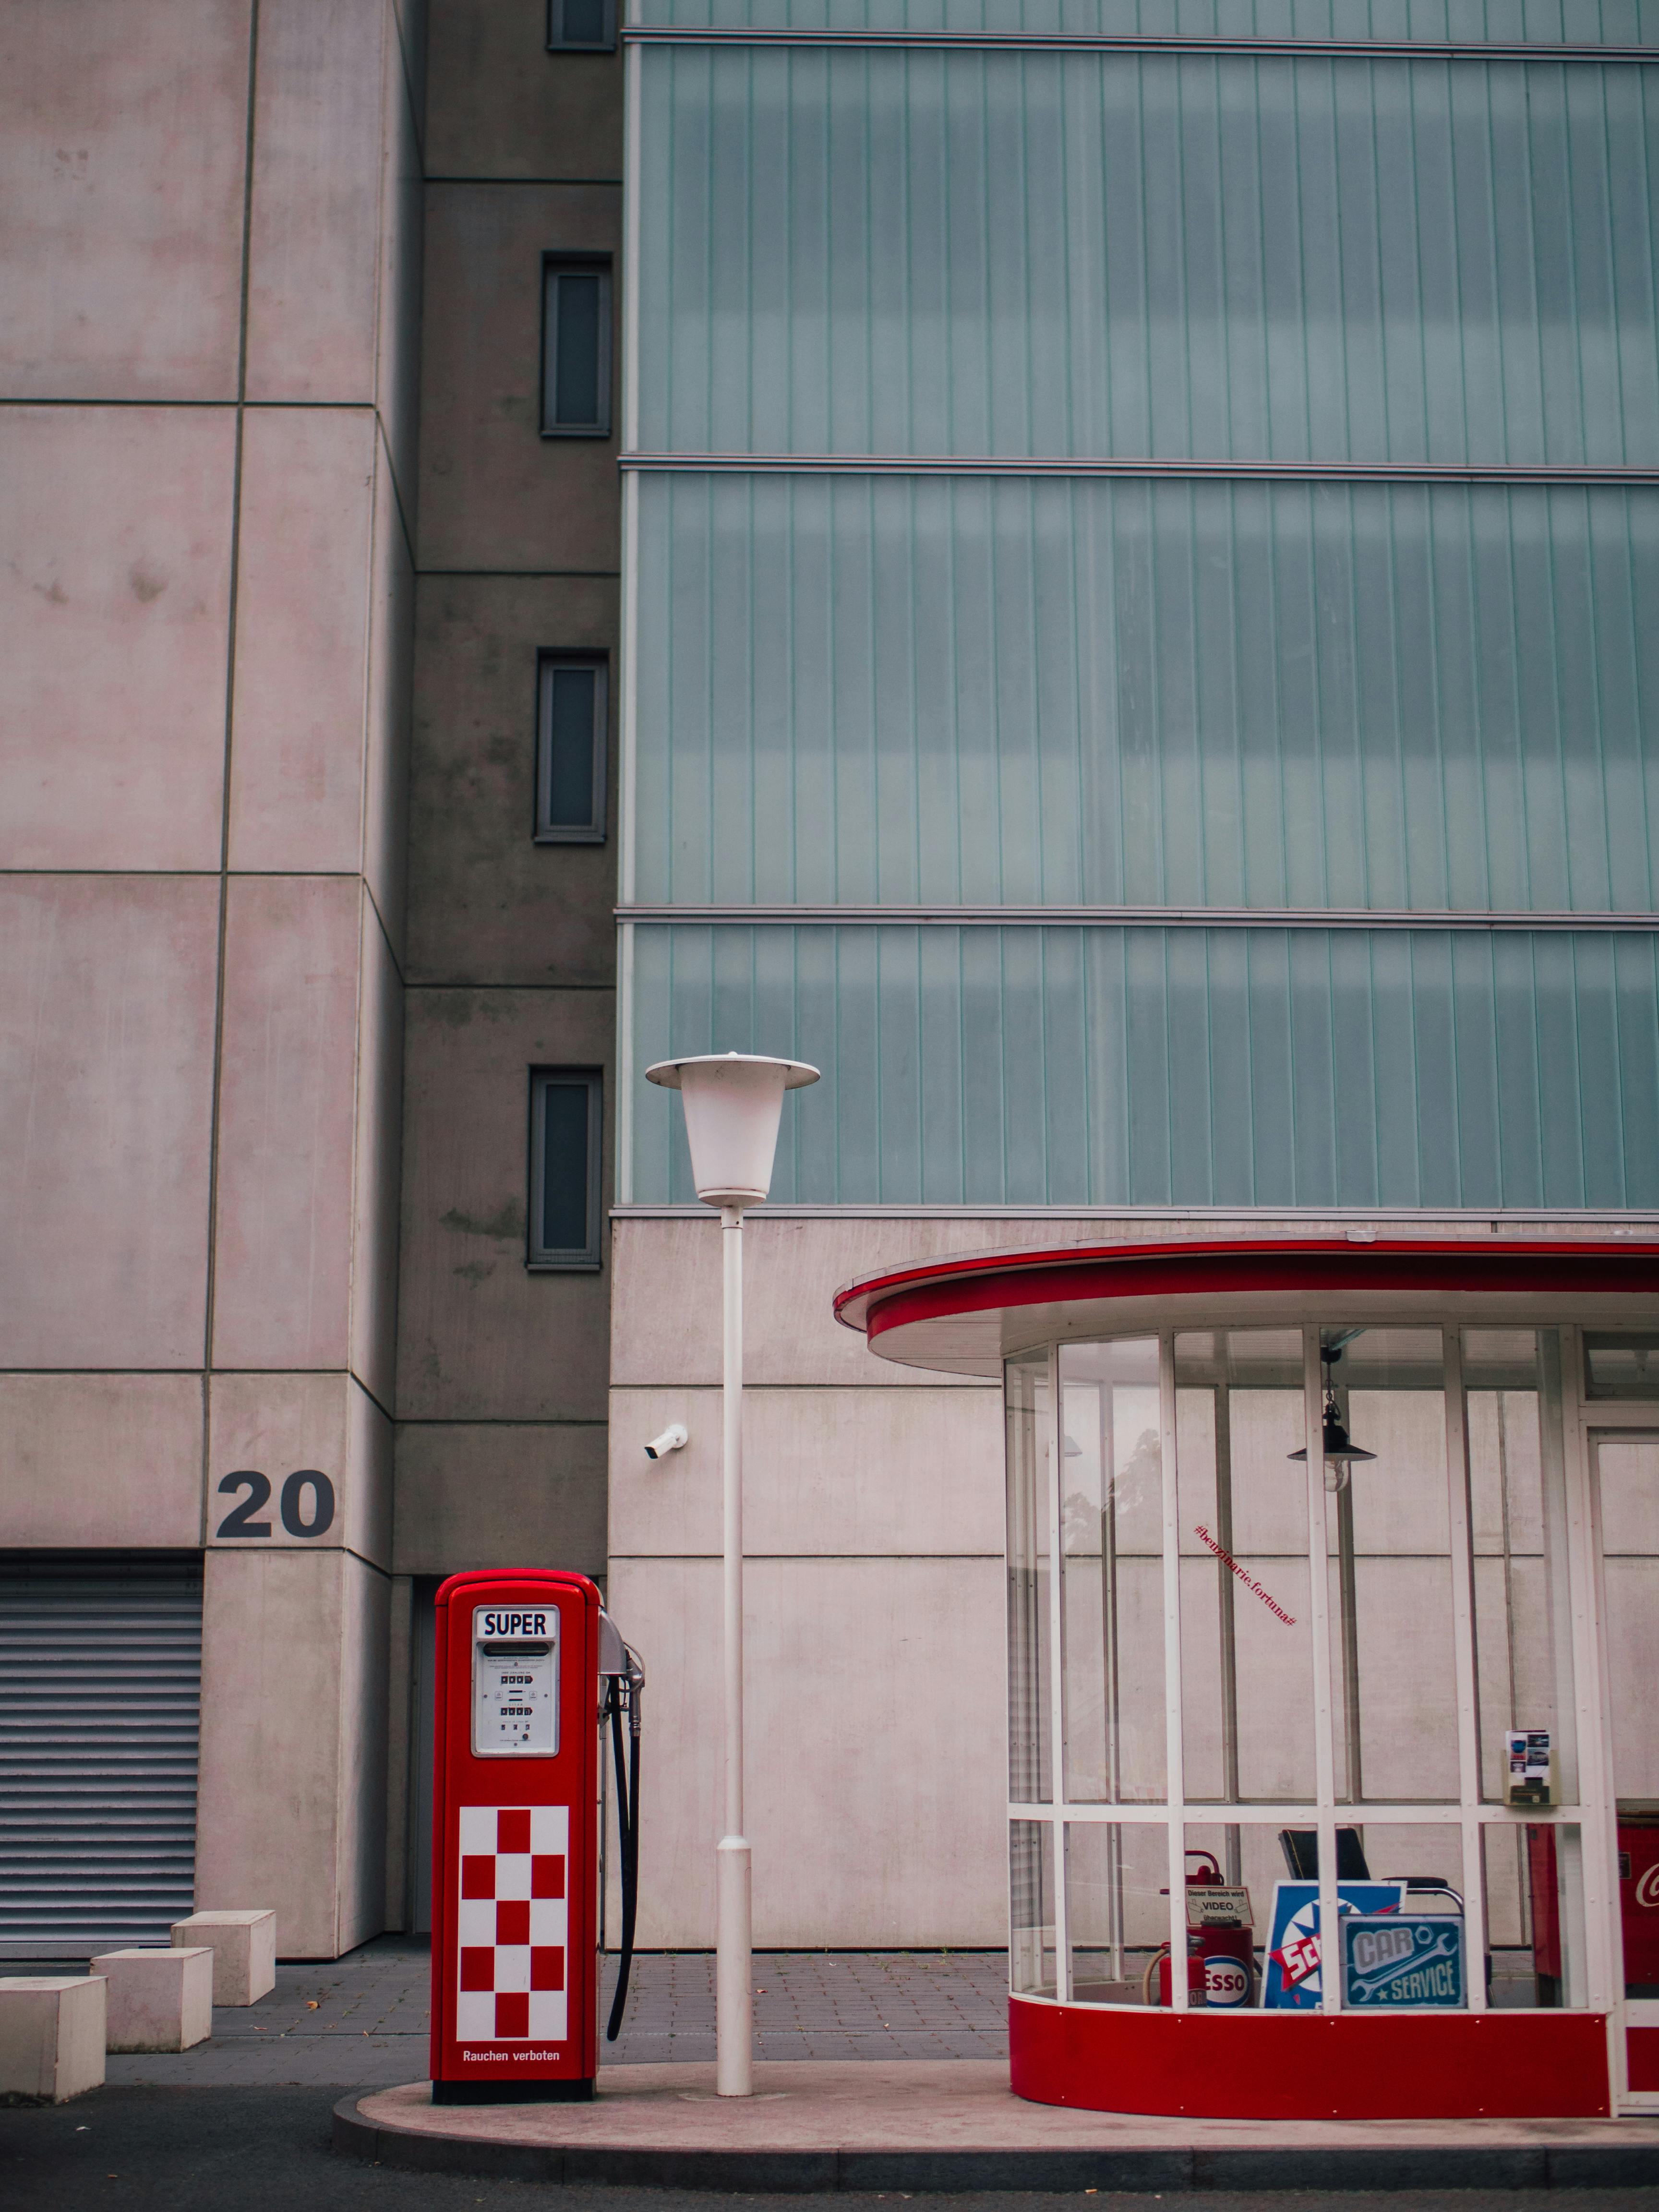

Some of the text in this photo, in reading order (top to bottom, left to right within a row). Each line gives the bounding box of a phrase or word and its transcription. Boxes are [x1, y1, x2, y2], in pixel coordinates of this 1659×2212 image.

[216, 1469, 335, 1538] 20
[484, 1613, 546, 1635] SUPER
[1202, 1902, 1234, 1910] VIDEO
[1357, 1929, 1412, 1968] CAR
[1391, 1960, 1455, 2000] SERVICE
[463, 2050, 560, 2061] Rauchen verboten
